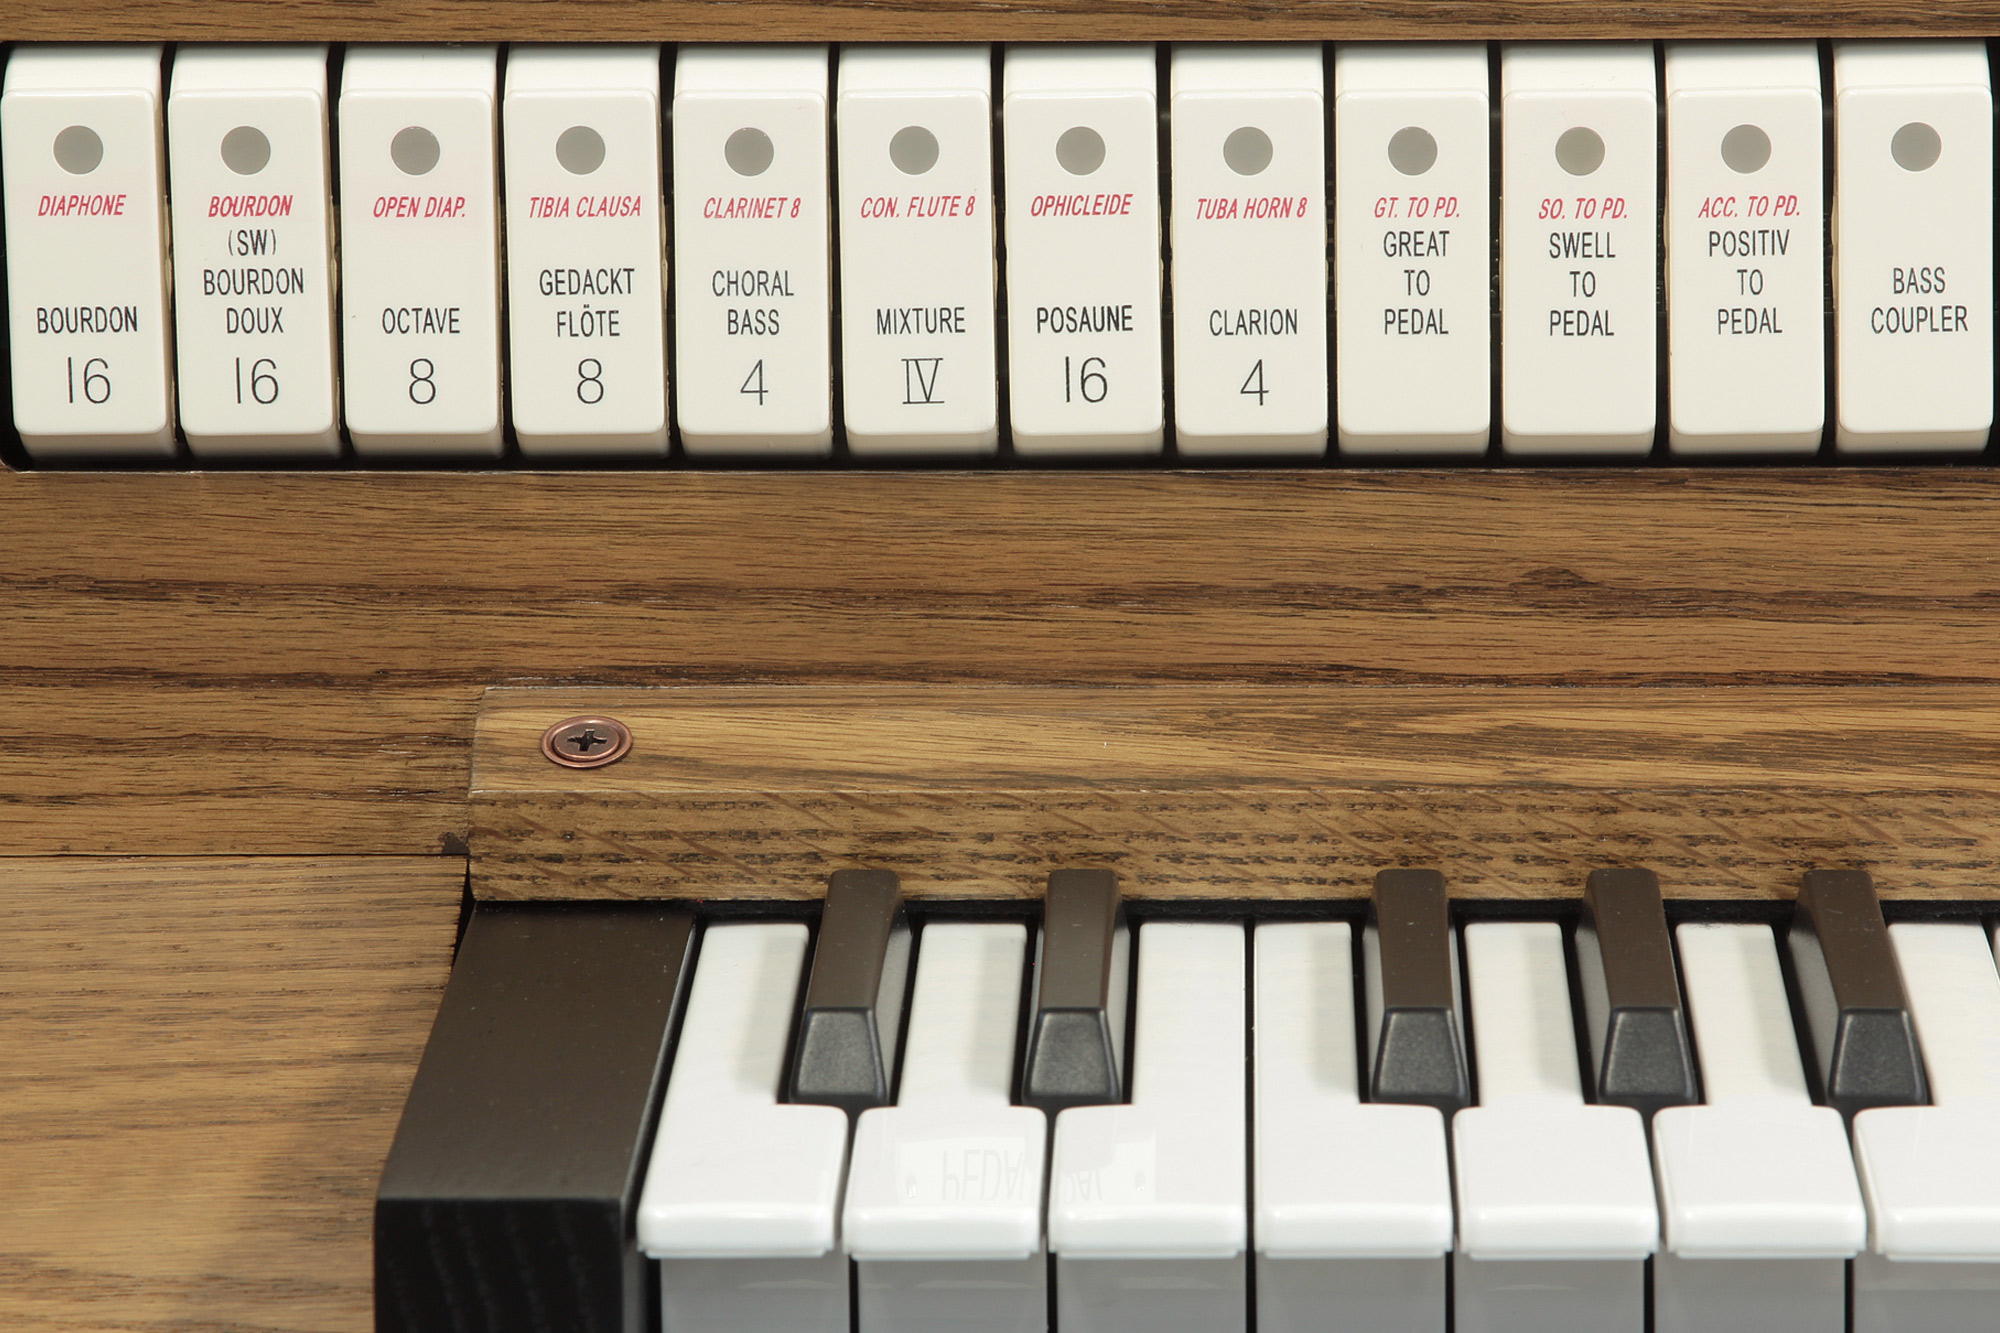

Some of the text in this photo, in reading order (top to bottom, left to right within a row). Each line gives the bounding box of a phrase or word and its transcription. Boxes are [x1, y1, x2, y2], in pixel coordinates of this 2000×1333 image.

[37, 194, 127, 217] DIAPHONE
[207, 194, 294, 218] BOURDON
[373, 196, 467, 218] OPEN DIAP.
[529, 195, 641, 219] TIBIA CLAUSA
[703, 197, 802, 219] CLARINET 8
[860, 195, 976, 219] CON. FLUTE 8
[1030, 193, 1134, 217] OPHICLEIDE
[1196, 196, 1308, 220] TUBA HORN 8
[1374, 196, 1461, 219] GT. TO PD.
[1538, 197, 1629, 220] SO. TO PD.
[1697, 194, 1802, 219] ACC. TO PD.
[227, 228, 277, 257] (SW)
[1383, 230, 1451, 258] GREAT
[1549, 231, 1617, 259] SWELL
[1708, 228, 1790, 258] POSITIV
[203, 267, 304, 296] BOURDON
[539, 267, 635, 297] GEDACKT
[711, 269, 795, 297] CHORAL
[1403, 269, 1431, 297] TO
[1569, 270, 1596, 298] TO
[1736, 268, 1764, 296] TO
[1893, 266, 1946, 295] BASS
[36, 305, 138, 335] BOURDON
[226, 306, 284, 335] DOUX
[381, 307, 461, 335] OCTAVE
[556, 303, 621, 338] FLÖTE
[727, 308, 780, 336] BASS
[876, 306, 966, 335] MIXTURE
[1036, 304, 1134, 334] POSAUNE
[1209, 308, 1298, 337] CLARION
[1384, 308, 1450, 335] PEDAL
[1549, 309, 1615, 337] PEDAL
[1717, 307, 1783, 335] PEDAL
[1871, 305, 1969, 335] COUPLER
[67, 356, 111, 405] 16
[235, 356, 279, 405] 16
[408, 357, 437, 405] 8
[576, 358, 605, 405] 8
[739, 358, 769, 406] 4
[900, 357, 945, 405] IV
[1064, 355, 1108, 404] 16
[1239, 358, 1270, 407] 4
